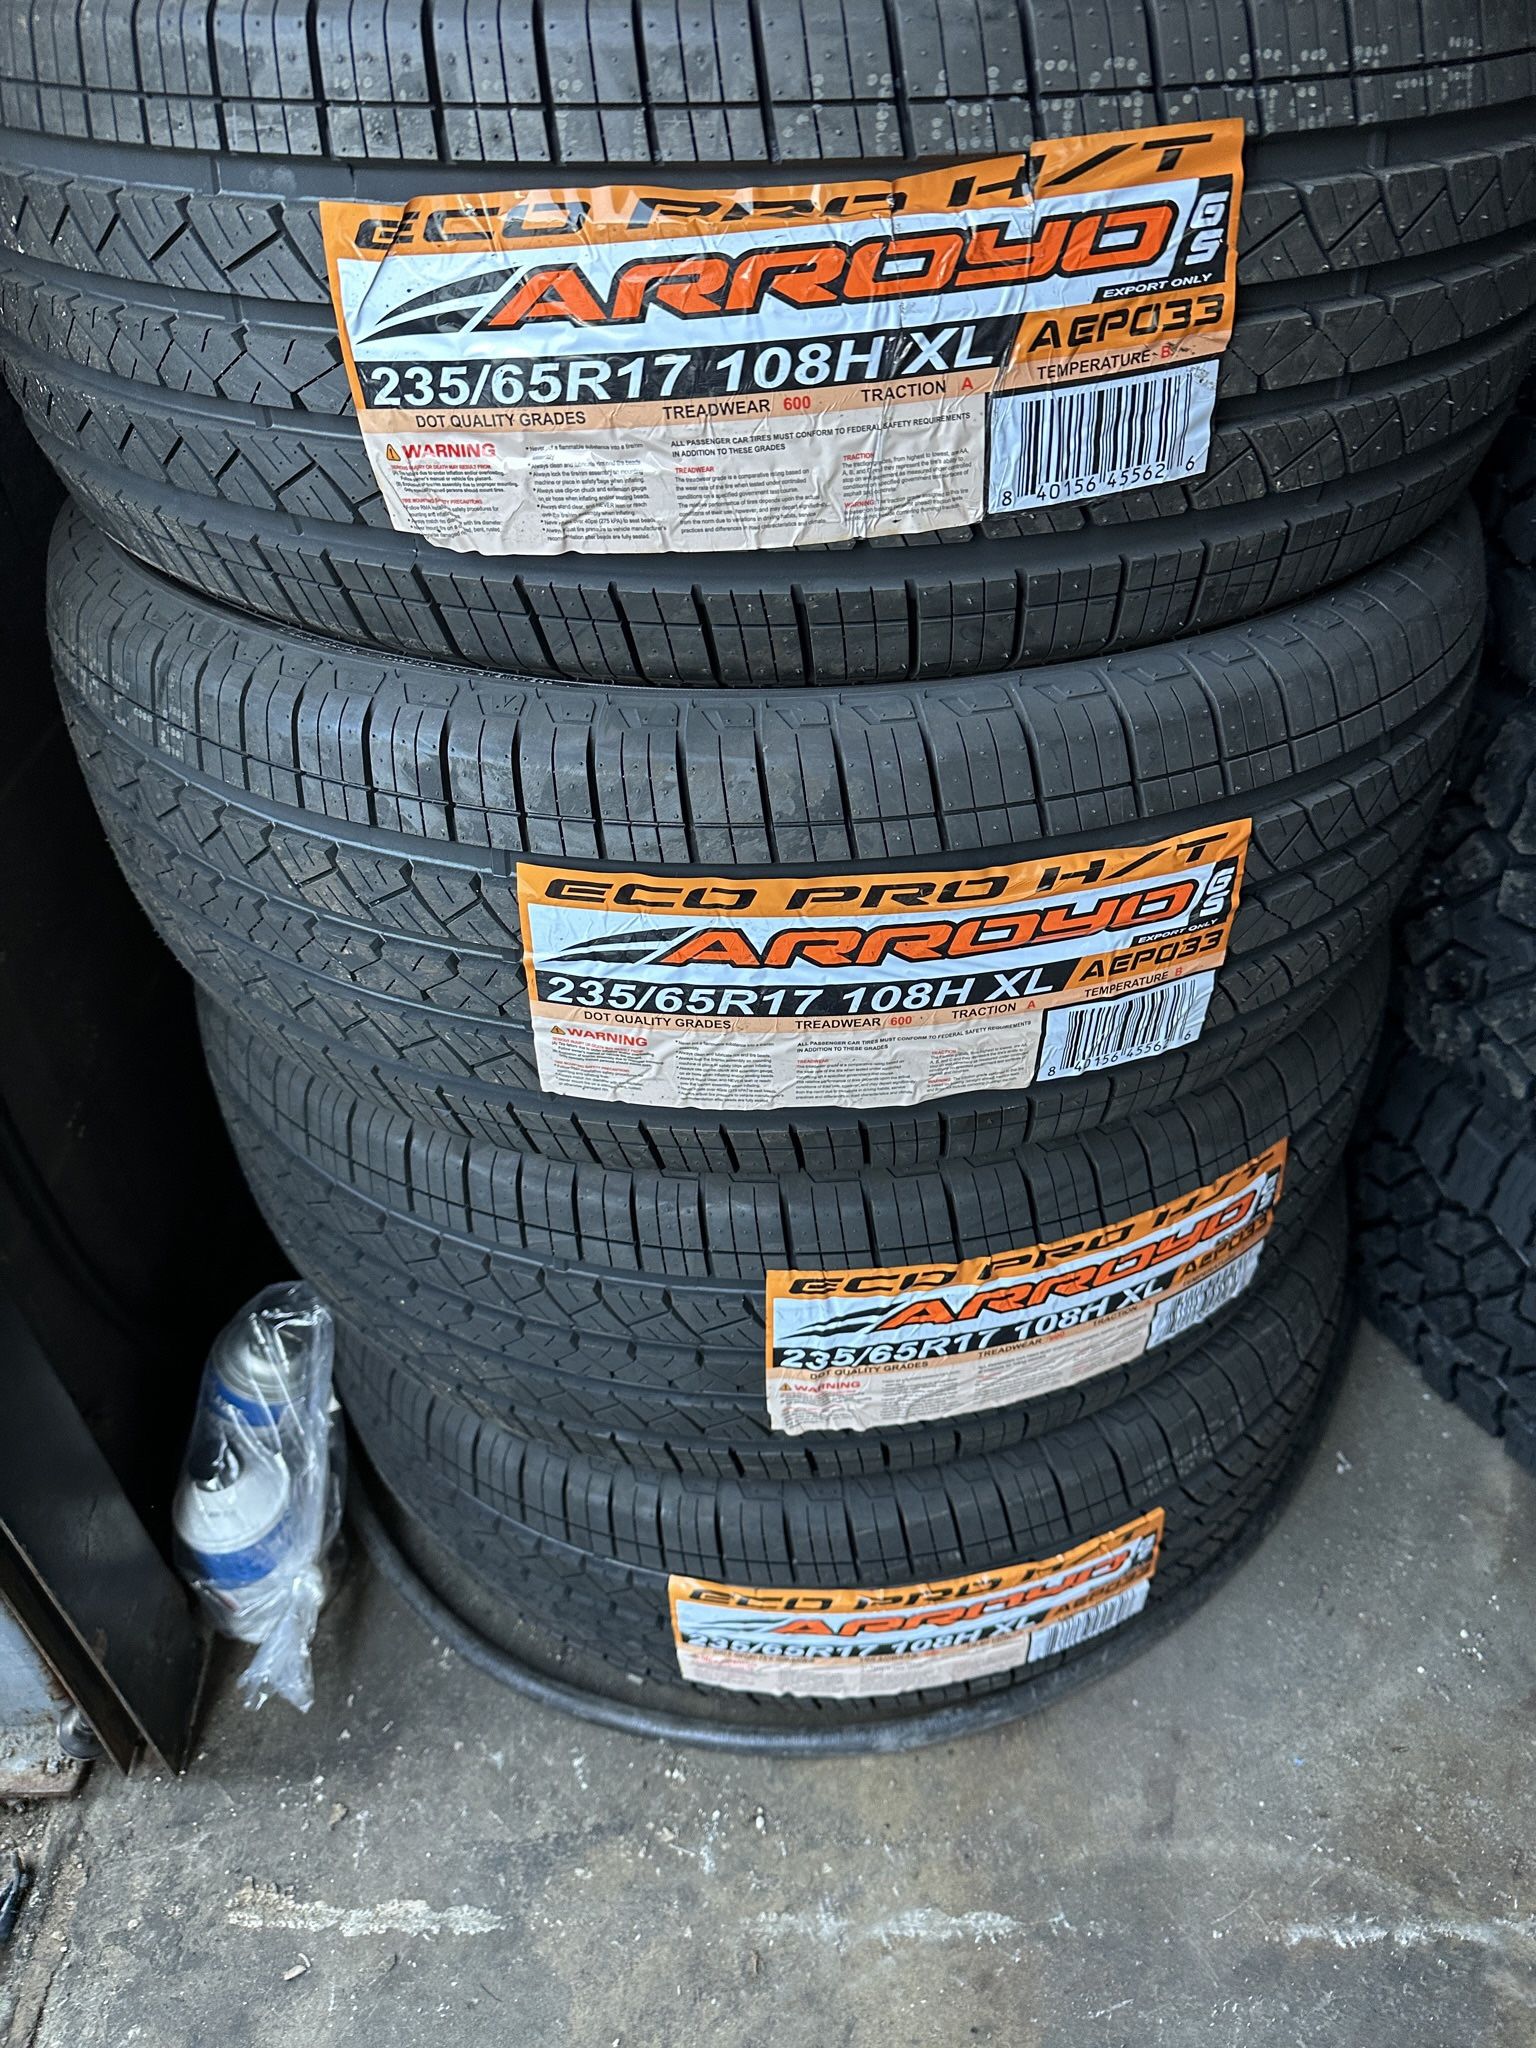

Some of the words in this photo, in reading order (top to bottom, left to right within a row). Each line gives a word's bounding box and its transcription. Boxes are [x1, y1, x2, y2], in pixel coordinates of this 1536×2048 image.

[355, 201, 591, 250] ECO
[627, 192, 908, 230] PRO
[946, 133, 1214, 207] H/T
[470, 199, 1180, 332] ARROYO
[1102, 280, 1169, 299] EXPORT
[1170, 272, 1213, 288] ONLY
[1027, 293, 1225, 354] AEP033
[371, 353, 692, 407] 235/65R17
[716, 336, 886, 393] 108H
[901, 325, 994, 376] XL
[1037, 350, 1151, 381] TEMPERATURE
[415, 414, 446, 428] DOT
[449, 412, 515, 428] QUALITY
[520, 410, 587, 427] GRADES
[662, 398, 771, 420] TREADWEAR
[782, 394, 812, 411] 600
[860, 380, 947, 403] TRACTION
[960, 377, 974, 392] A
[401, 442, 497, 459] WARNING
[671, 440, 686, 448] ALL
[686, 436, 731, 446] PASSENGER
[732, 436, 749, 445] CAR
[749, 434, 772, 443] TIRES
[773, 431, 795, 441] MUST
[795, 428, 834, 440] CONFORM
[834, 427, 846, 436] TO
[846, 423, 883, 435] FEDERAL
[882, 419, 912, 430] SAFETY
[913, 411, 971, 427] REQUIREMENTS
[681, 449, 716, 458] ADDITION
[717, 447, 728, 456] TO
[728, 445, 754, 455] THESE
[754, 442, 787, 454] GRADES
[674, 465, 716, 475] TREADWEAR
[1001, 490, 1013, 507] 8
[1036, 476, 1097, 501] 40156
[1106, 463, 1166, 488] 45562
[1185, 455, 1196, 472] 6
[545, 878, 758, 910] ECO
[785, 875, 1009, 911] PRO
[1035, 831, 1230, 893] H/T
[644, 878, 1201, 969] ARROYO
[1137, 926, 1186, 944] EXPORT
[1188, 917, 1219, 932] ONLY
[1078, 928, 1225, 982] AEP033
[546, 975, 824, 1016] 235/65R17
[842, 976, 977, 1014] 108H
[984, 966, 1054, 1002] XL
[1084, 970, 1170, 998] TEMPERATURE
[1174, 965, 1183, 977] B
[566, 1027, 649, 1047] WARNING
[583, 1010, 620, 1023] DOT
[622, 1013, 671, 1028] QUALITY
[674, 1017, 732, 1030] GRADES
[794, 1017, 881, 1030] TREADWEAR
[889, 1015, 913, 1026] 600
[951, 1001, 1017, 1020] TRACTION
[1026, 1000, 1037, 1010] A
[937, 1031, 964, 1039] FEDERAL
[965, 1027, 987, 1036] SAFETY
[987, 1020, 1032, 1031] REQUIREMENTS
[804, 1045, 833, 1053] ADDITION
[863, 1043, 889, 1051] GRADES
[1047, 1065, 1056, 1077] 8
[1073, 1053, 1120, 1073] 40156
[1184, 1031, 1192, 1042] 6
[788, 1270, 958, 1295] ECO
[977, 1223, 1136, 1281] PRO
[865, 1188, 1258, 1335] ARROYO
[780, 1329, 1002, 1372] 235/65R17
[1014, 1295, 1111, 1341] 108H
[1115, 1278, 1164, 1310] XL
[809, 1370, 832, 1380] DOT
[834, 1365, 881, 1377] QUALITY
[882, 1361, 929, 1373] GRADES
[976, 1336, 1043, 1360] TREADWEAR
[1092, 1305, 1138, 1327] TRACTION
[793, 1380, 861, 1394] WARNING
[891, 1627, 983, 1655] 108H
[988, 1615, 1036, 1637] XL
